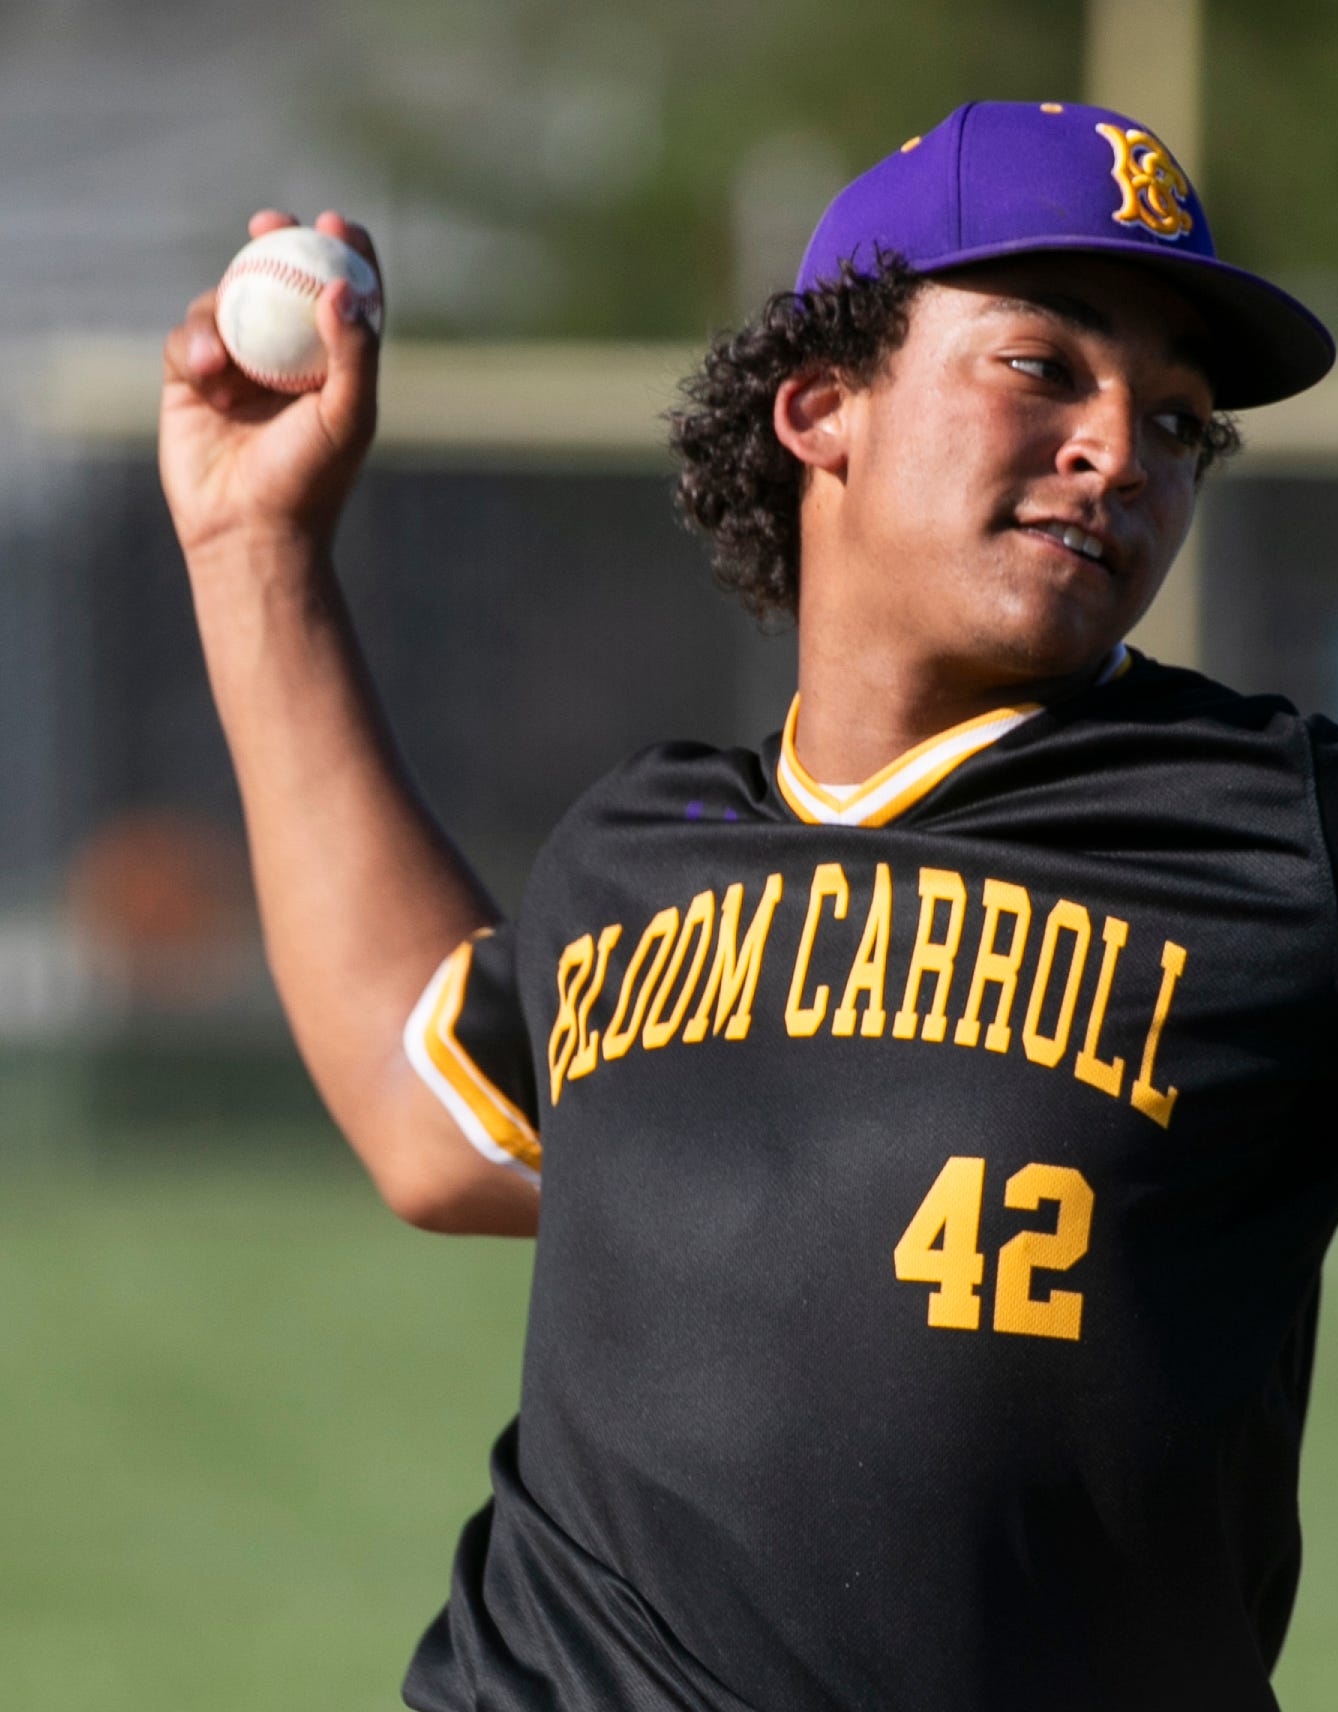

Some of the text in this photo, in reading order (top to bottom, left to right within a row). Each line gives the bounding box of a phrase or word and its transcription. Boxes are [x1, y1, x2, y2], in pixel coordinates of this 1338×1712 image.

[548, 862, 1187, 1129] BLOOM CARROLL
[893, 1155, 1095, 1341] 42
